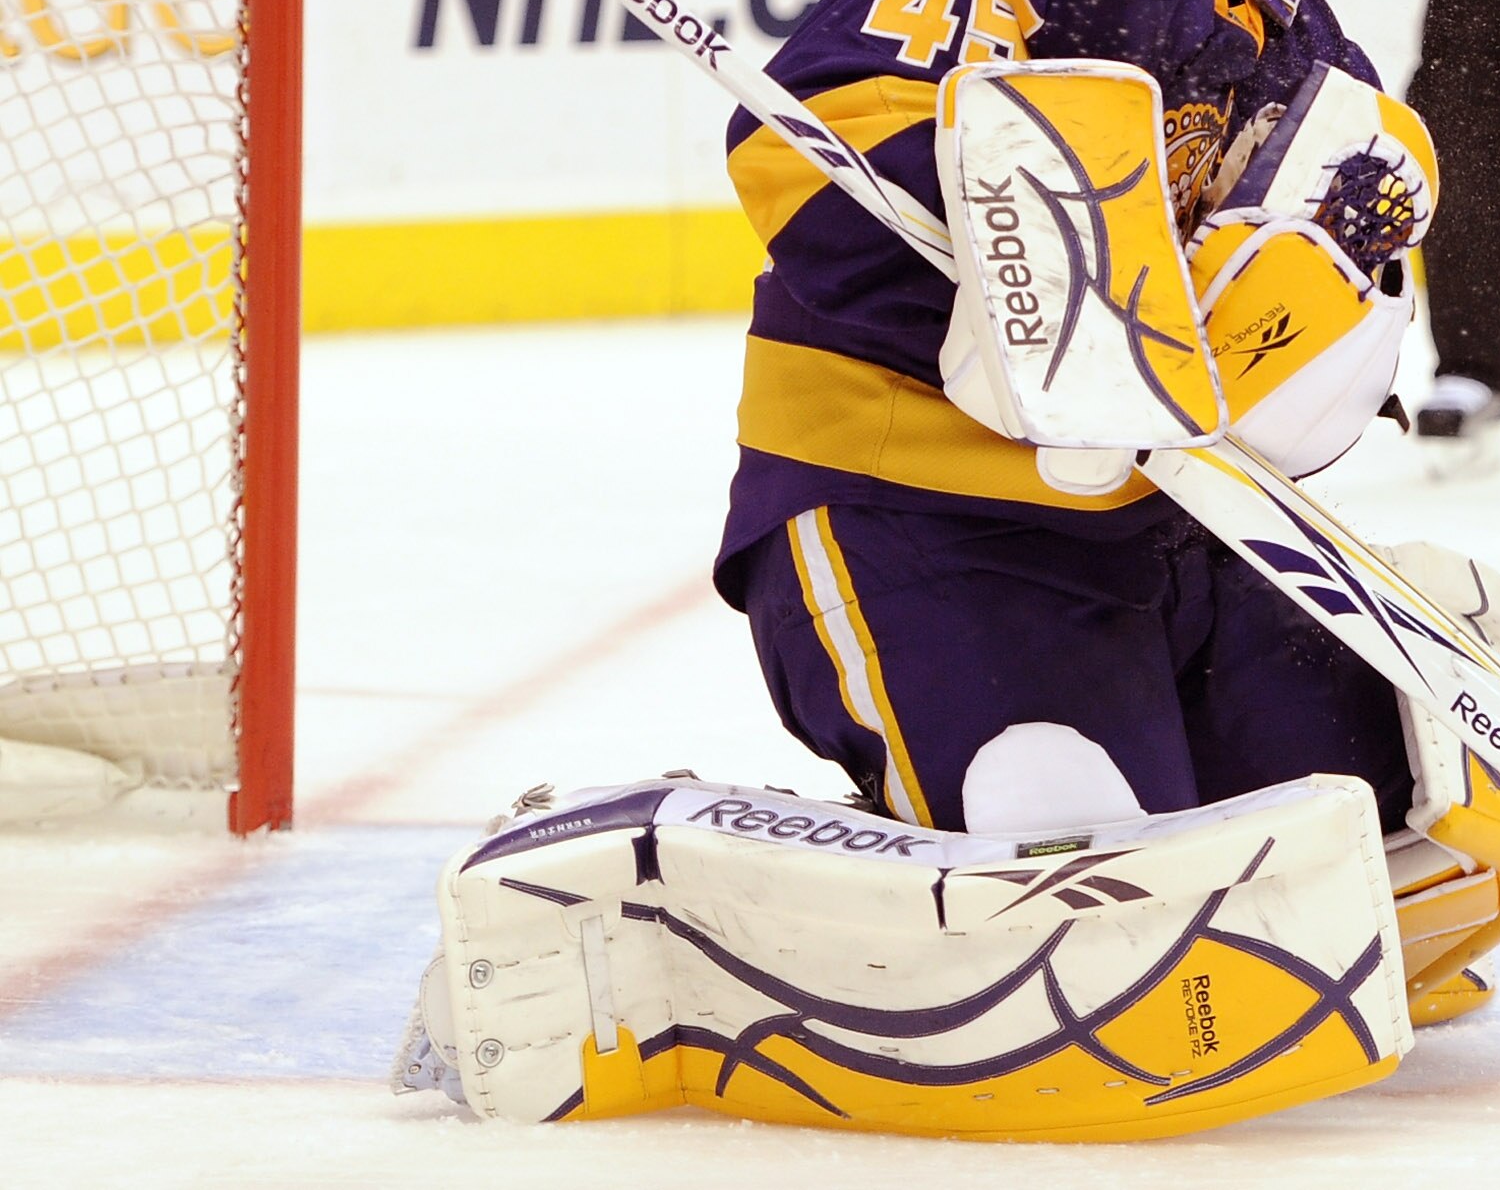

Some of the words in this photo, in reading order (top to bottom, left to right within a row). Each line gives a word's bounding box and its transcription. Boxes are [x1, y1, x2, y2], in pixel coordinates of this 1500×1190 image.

[973, 175, 1050, 347] Reebok
[1229, 301, 1287, 345] REVOKE
[686, 799, 938, 857] Reebok
[1028, 841, 1079, 857] Reebok
[1181, 978, 1199, 1037] REVOKE
[1190, 1038, 1202, 1060] PZ
[1192, 974, 1221, 1057] Reebok
